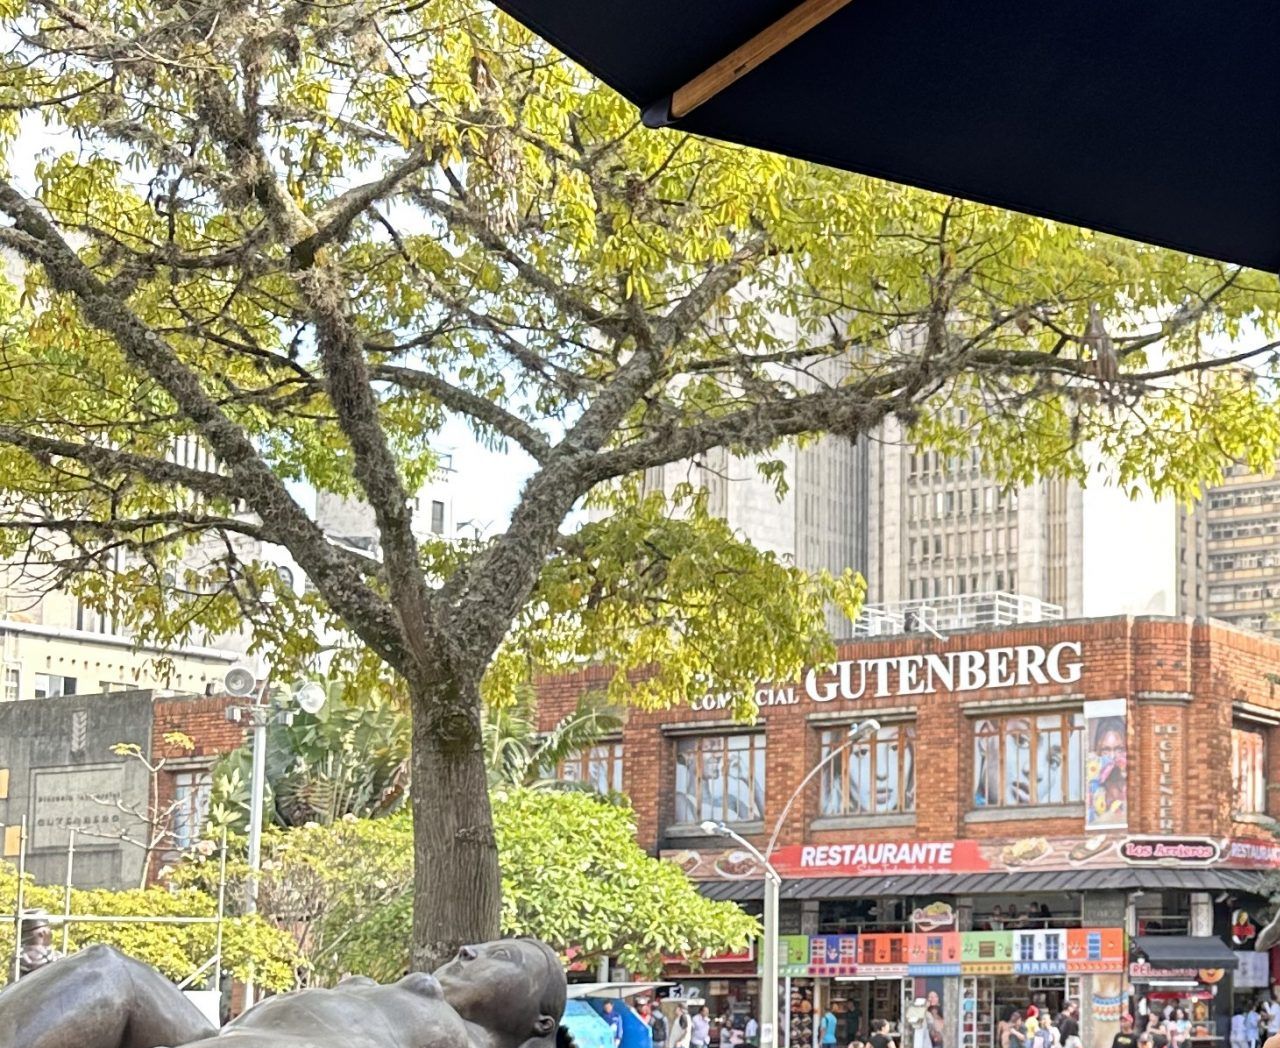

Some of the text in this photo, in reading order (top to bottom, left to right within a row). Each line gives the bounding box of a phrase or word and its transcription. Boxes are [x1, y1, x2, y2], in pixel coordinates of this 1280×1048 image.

[691, 687, 799, 711] COMCIAL
[805, 642, 1084, 702] GUTENBERG
[801, 843, 954, 867] RESTAURANTE
[1126, 842, 1152, 857] Los
